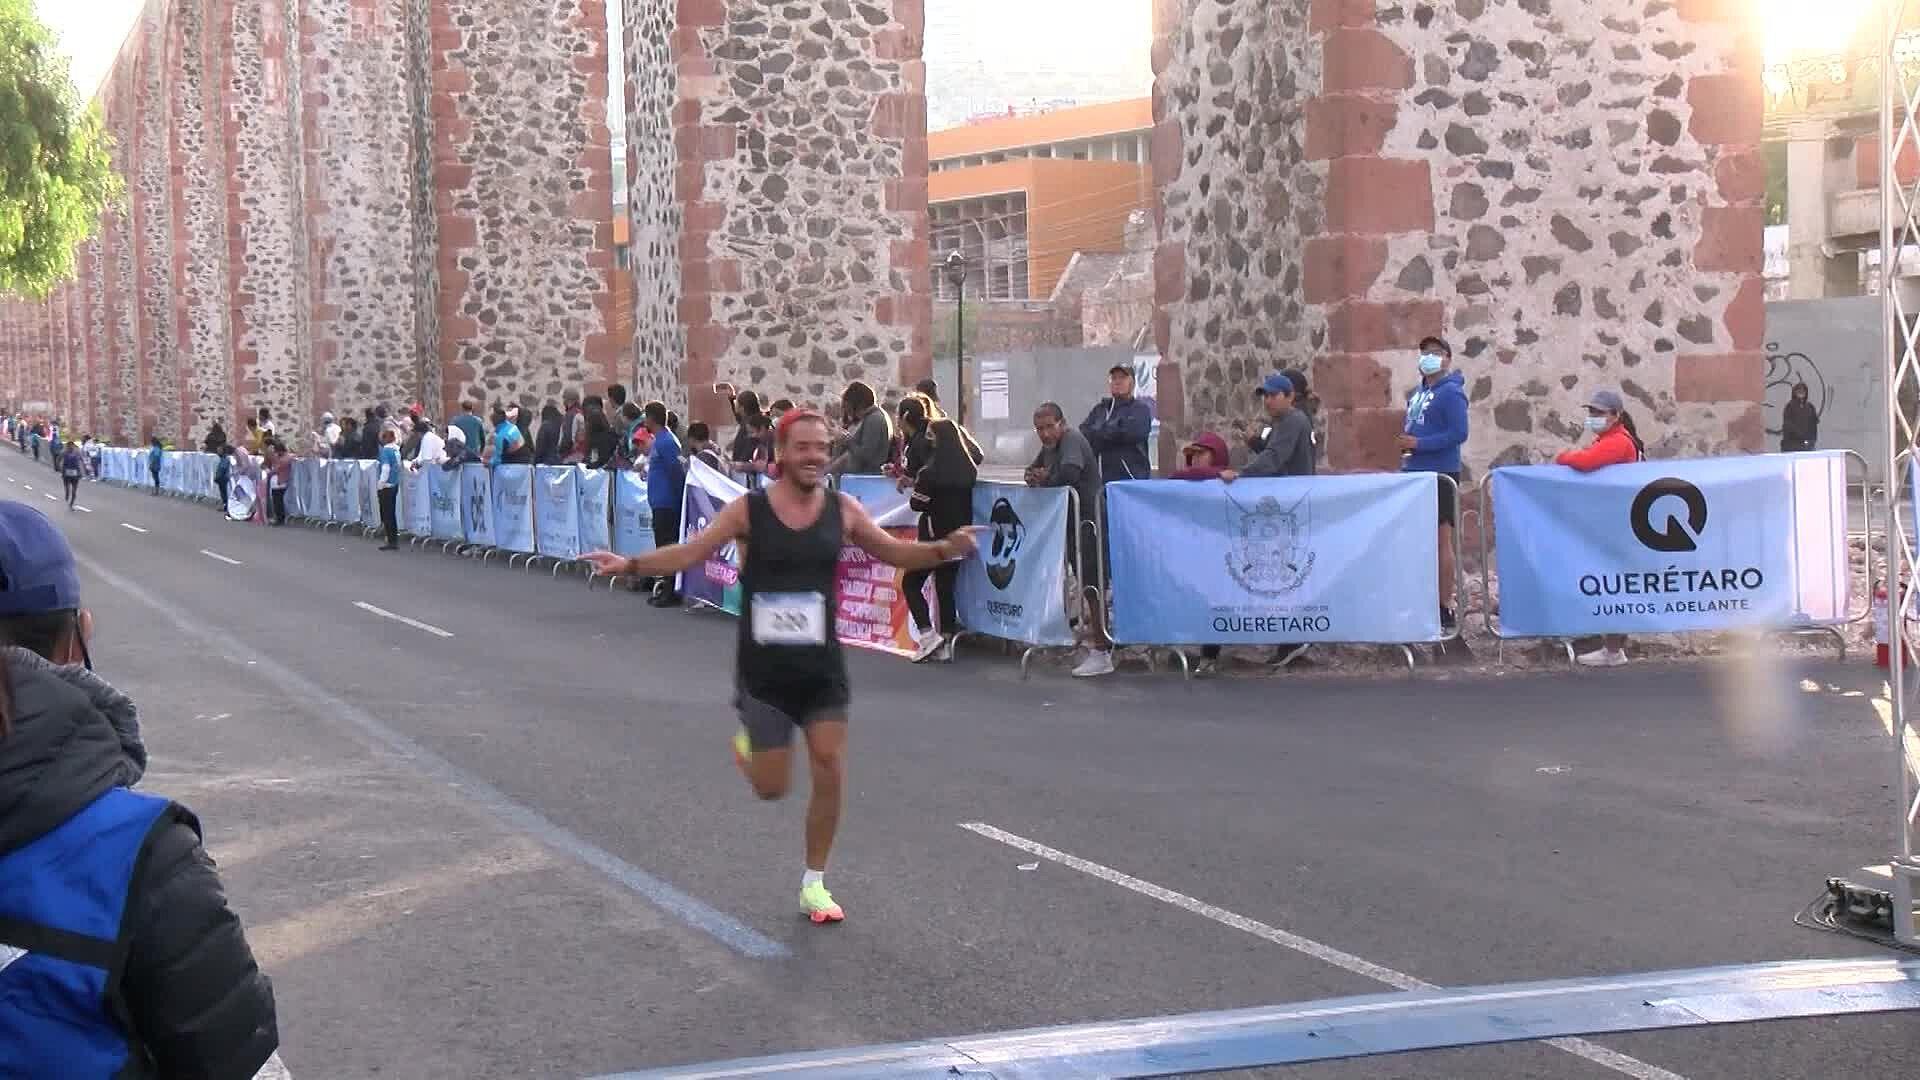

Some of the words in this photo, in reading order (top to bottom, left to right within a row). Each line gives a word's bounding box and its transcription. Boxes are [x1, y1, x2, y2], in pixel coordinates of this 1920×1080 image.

[1579, 565, 1764, 597] QUERÉTARO
[1592, 603, 1661, 616] JUNTOS,
[1664, 599, 1751, 614] ADELANTE
[1212, 613, 1331, 633] QUERÉTARO
